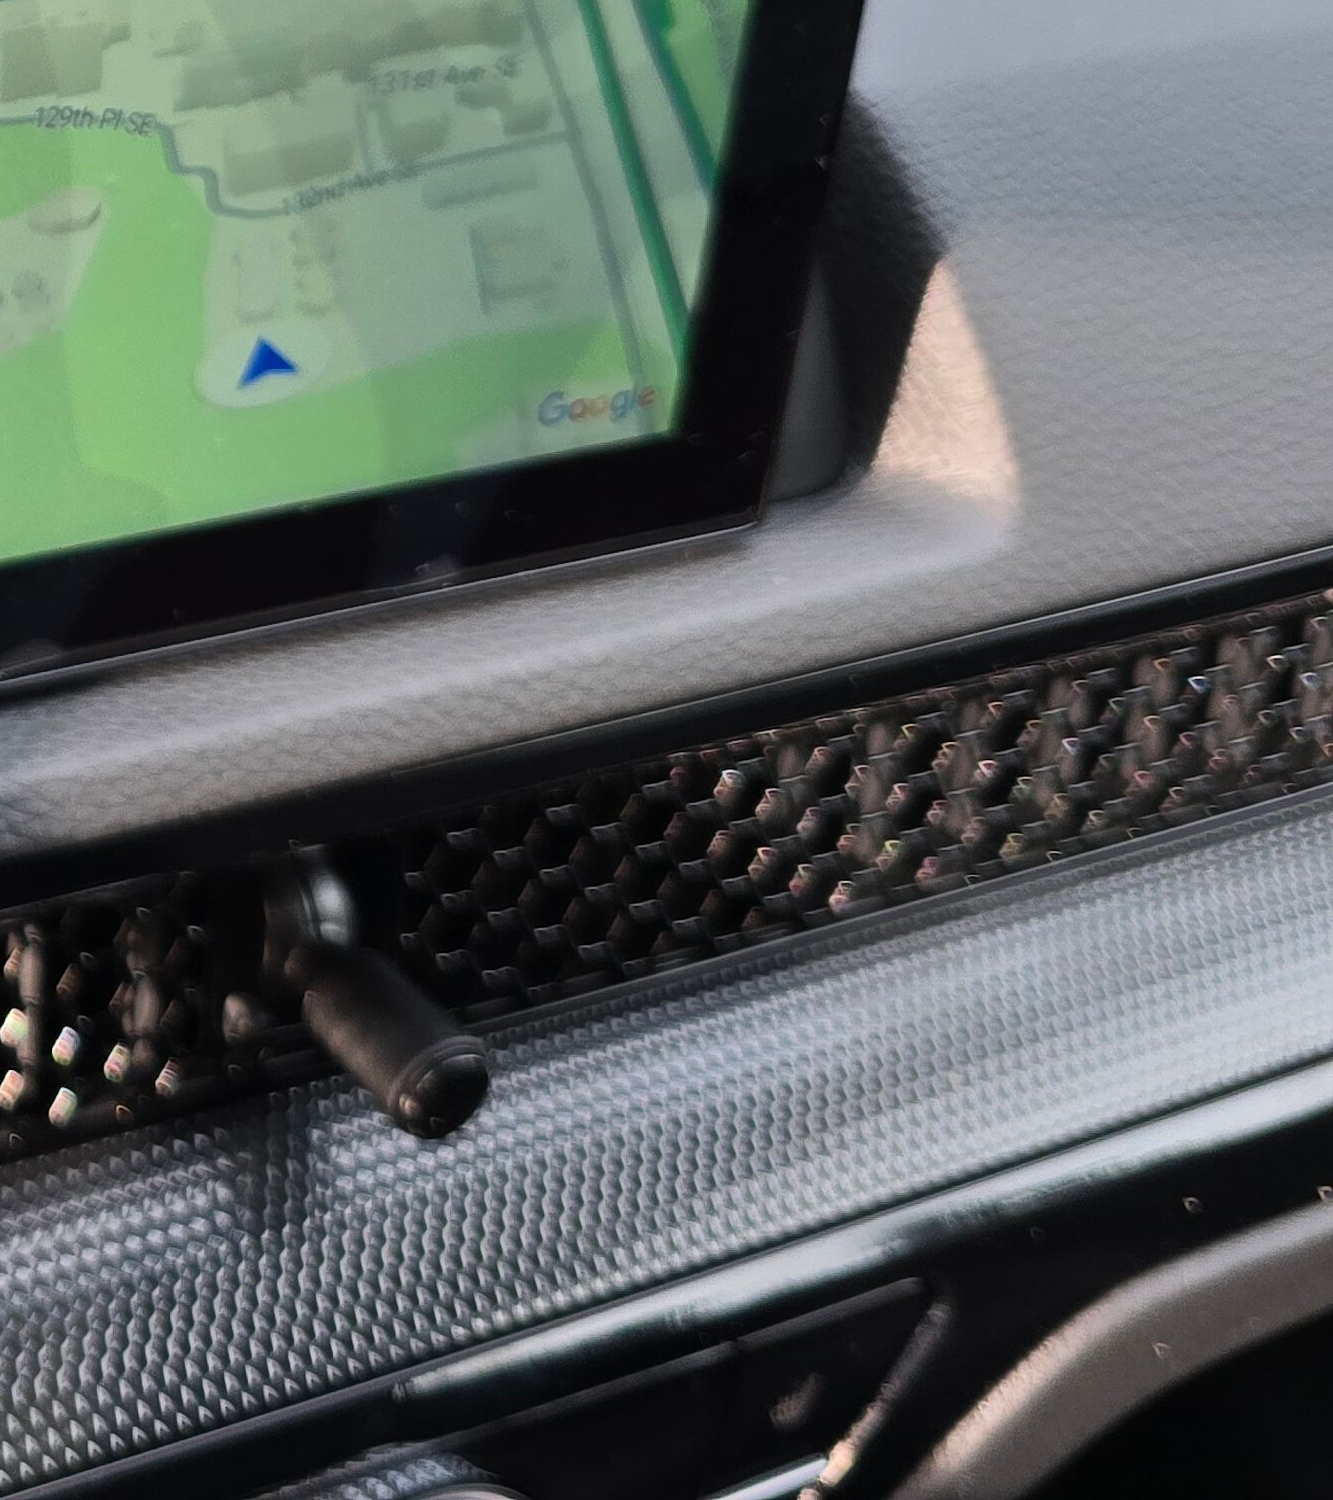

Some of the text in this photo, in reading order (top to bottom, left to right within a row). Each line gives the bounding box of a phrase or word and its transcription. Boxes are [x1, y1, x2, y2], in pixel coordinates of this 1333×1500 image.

[34, 106, 94, 130] 129th
[125, 111, 157, 135] SE
[537, 386, 657, 428] Google
